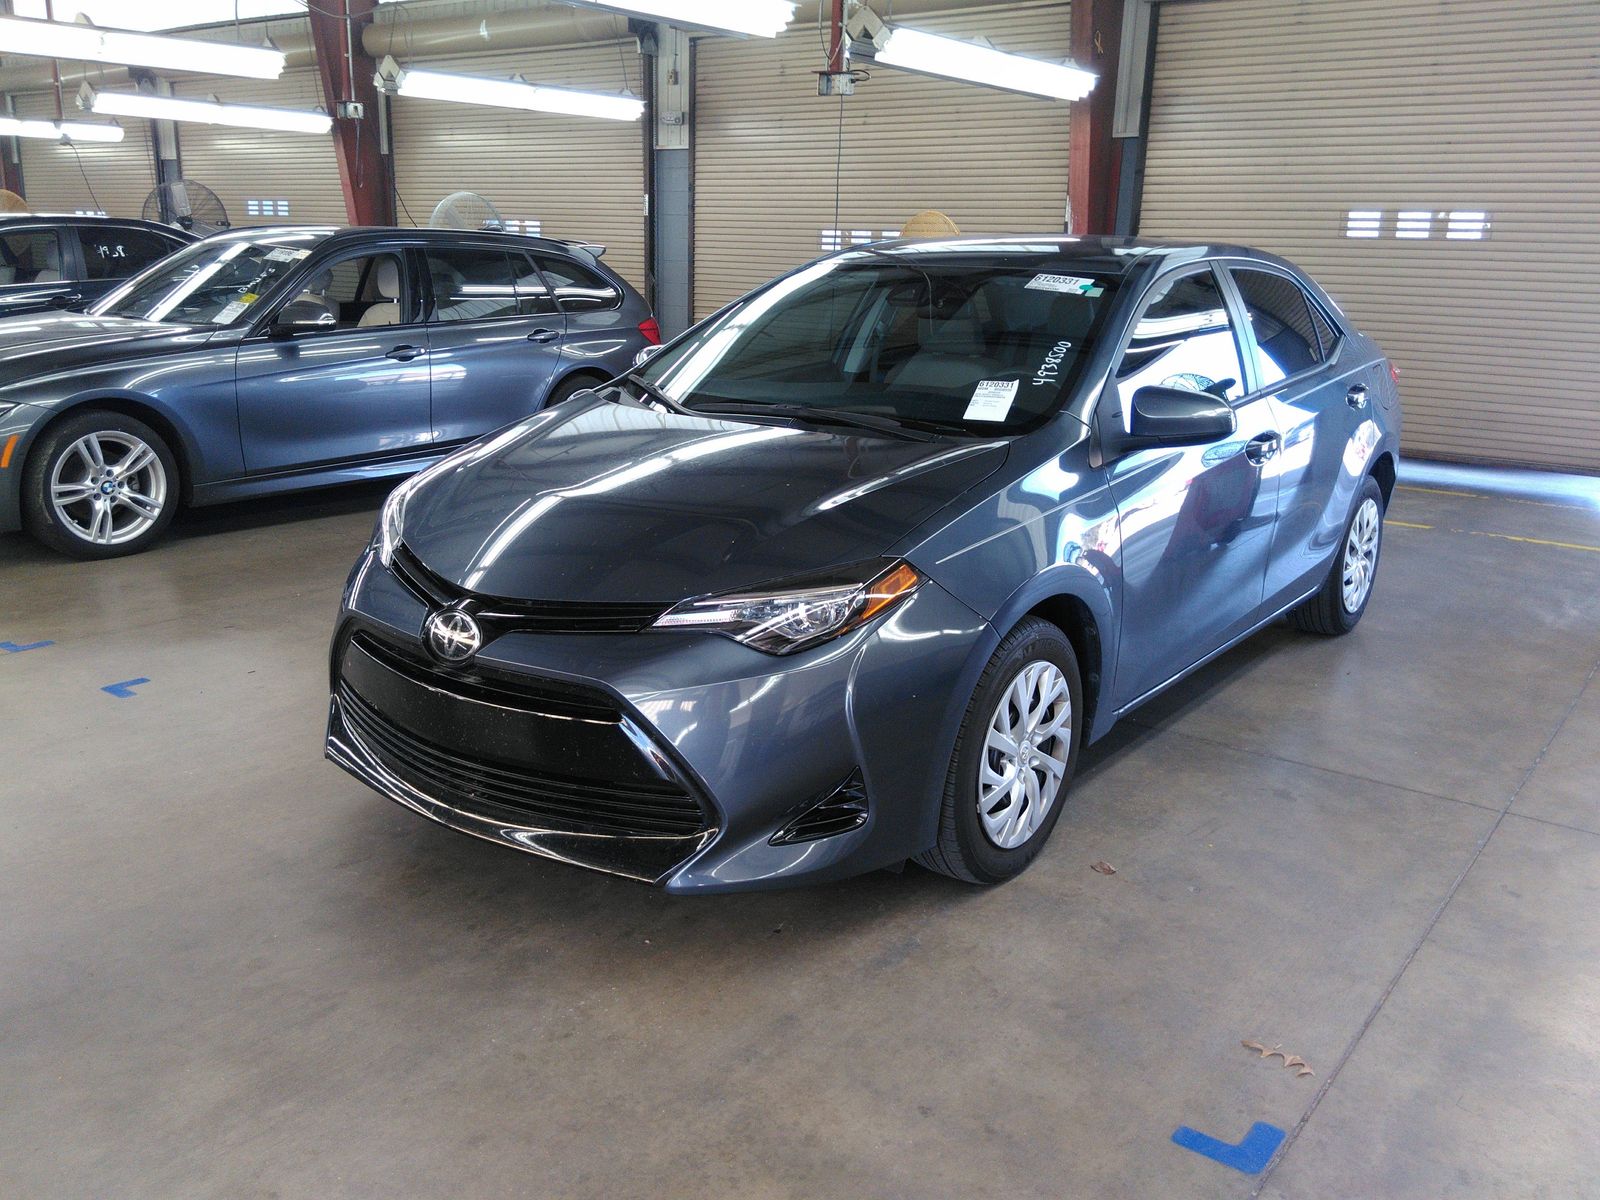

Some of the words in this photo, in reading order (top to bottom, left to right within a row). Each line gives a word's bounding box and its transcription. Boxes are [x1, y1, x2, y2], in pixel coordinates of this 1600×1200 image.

[1034, 274, 1079, 285] 6120331
[1032, 341, 1072, 385] 4938500
[979, 381, 1014, 389] 6120331
